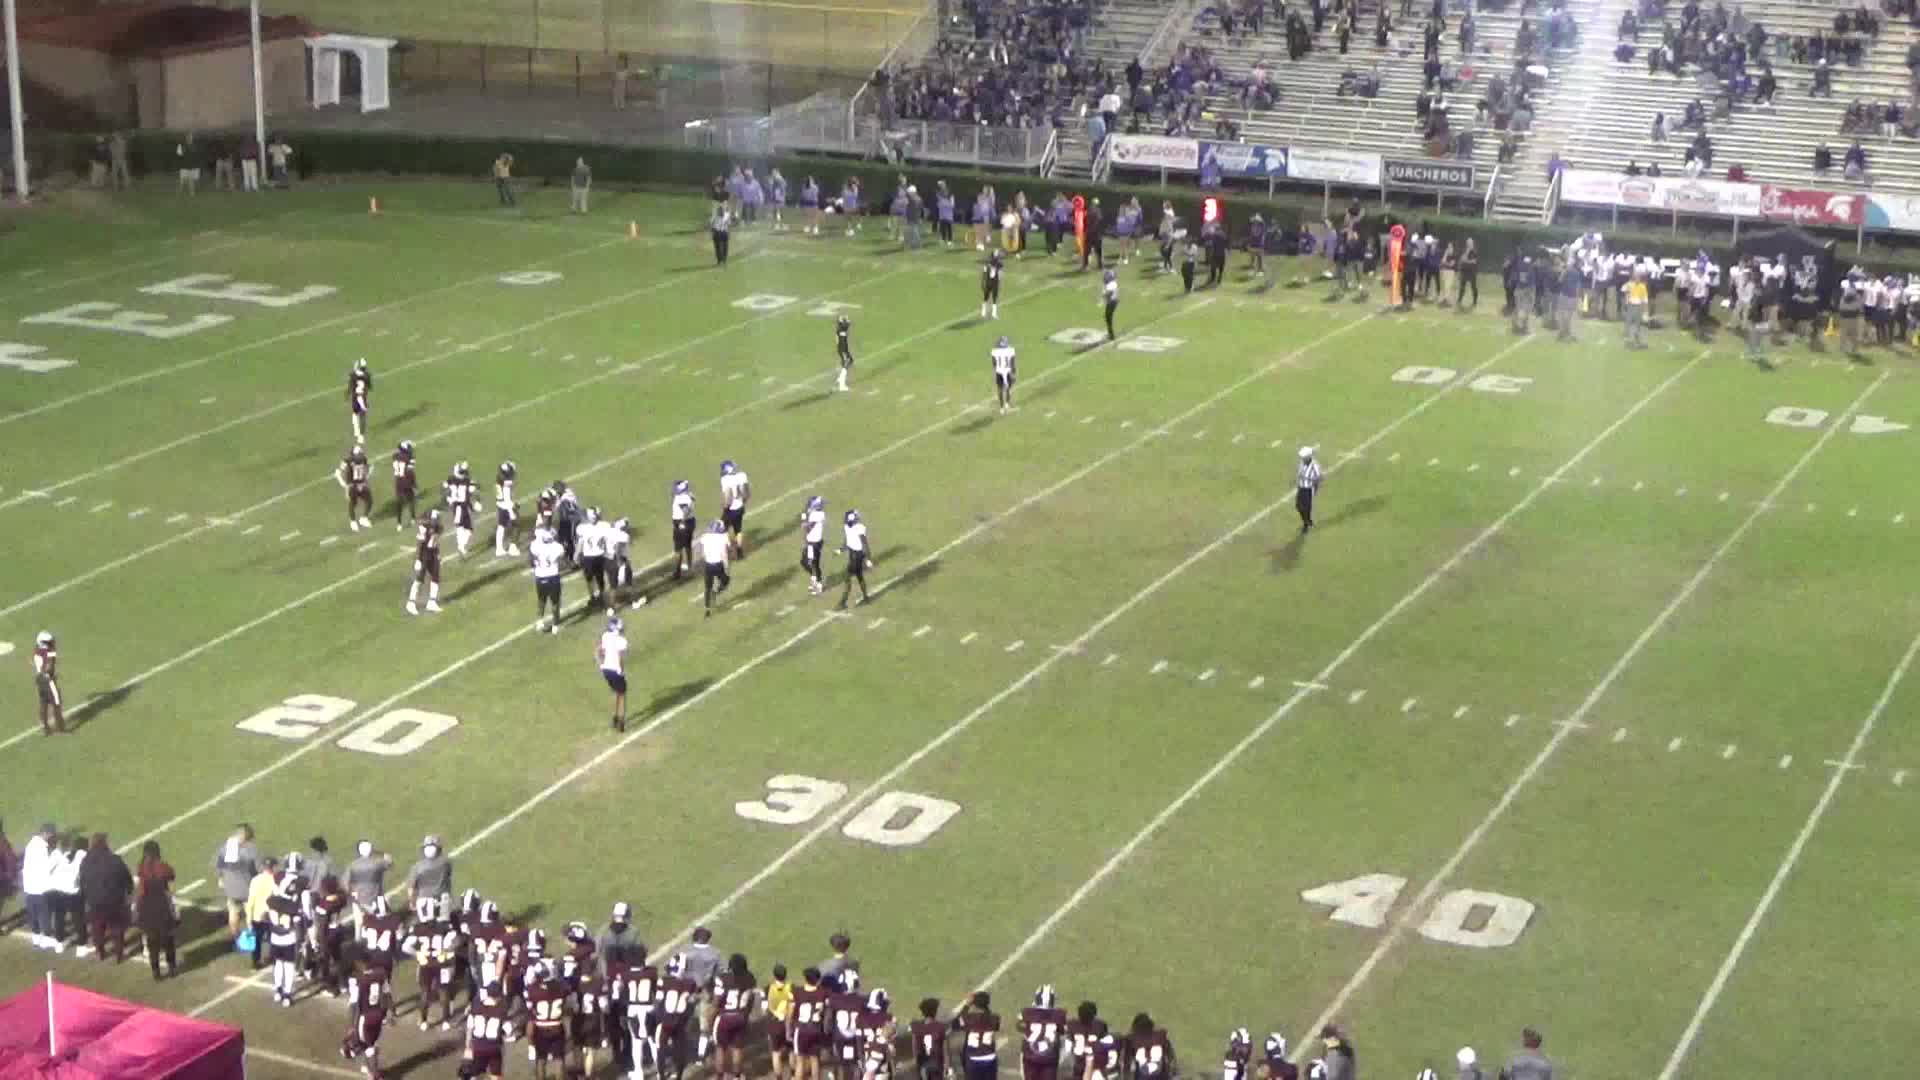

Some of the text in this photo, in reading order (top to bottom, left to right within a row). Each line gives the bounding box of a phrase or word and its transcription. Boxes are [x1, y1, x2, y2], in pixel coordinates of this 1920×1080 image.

[1204, 198, 1217, 222] 3
[1391, 366, 1535, 393] 30
[1765, 406, 1910, 433] 40
[235, 693, 459, 756] 20
[735, 773, 961, 846] 30
[1300, 872, 1536, 949] 40
